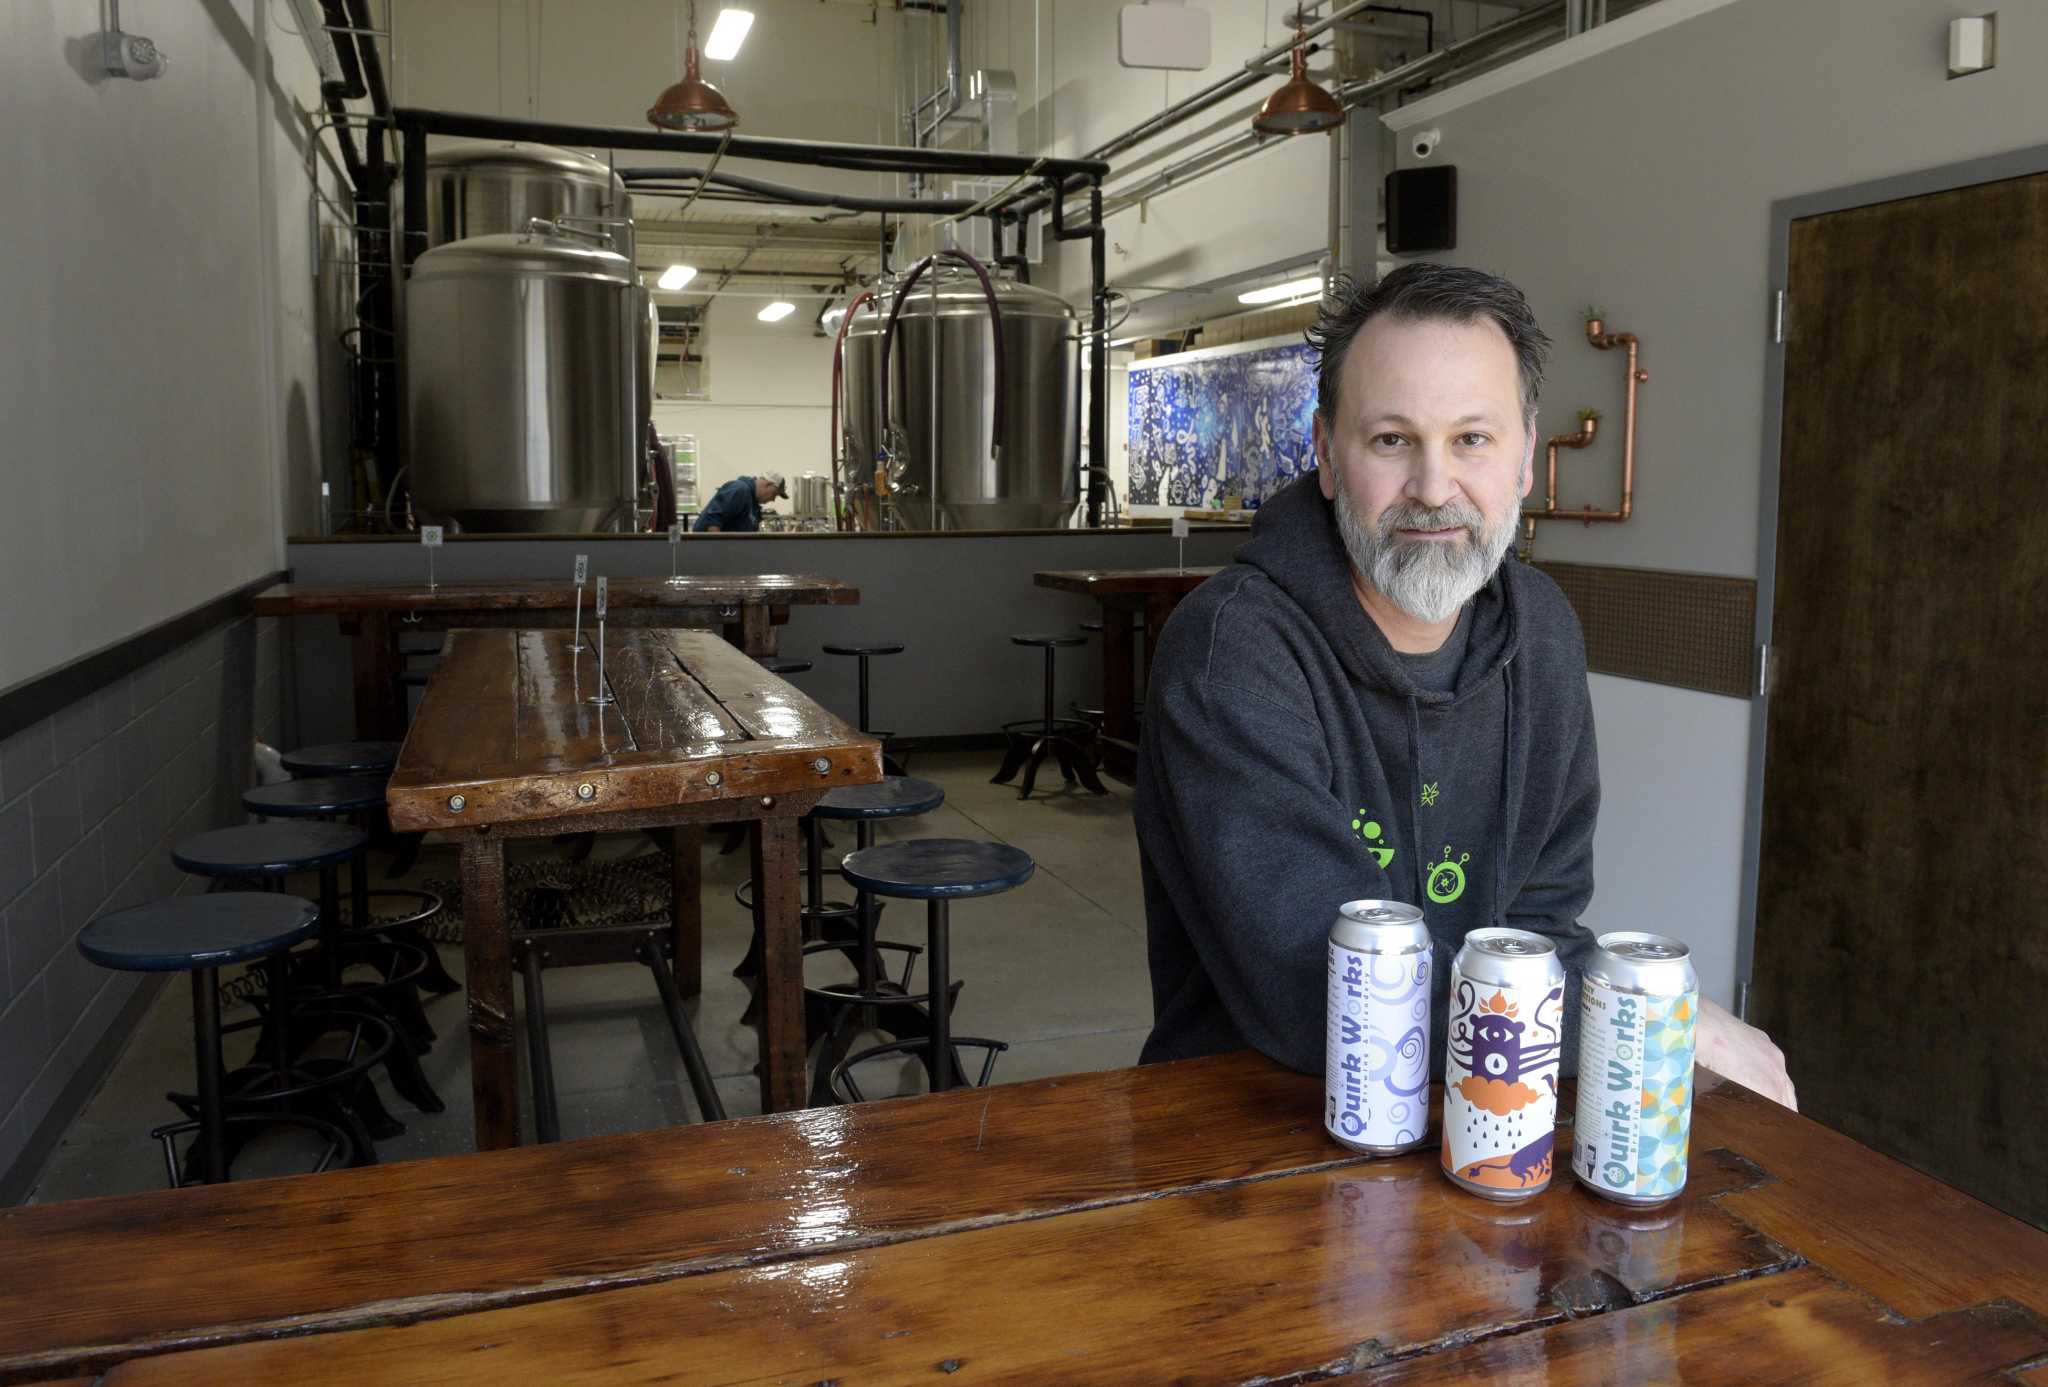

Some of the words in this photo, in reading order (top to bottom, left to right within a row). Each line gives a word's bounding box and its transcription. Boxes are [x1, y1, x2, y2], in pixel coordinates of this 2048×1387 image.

[1342, 955, 1363, 1045] Works
[1607, 997, 1637, 1092] Works
[1341, 1053, 1367, 1137] Quirk
[1603, 1101, 1635, 1188] Quirk
